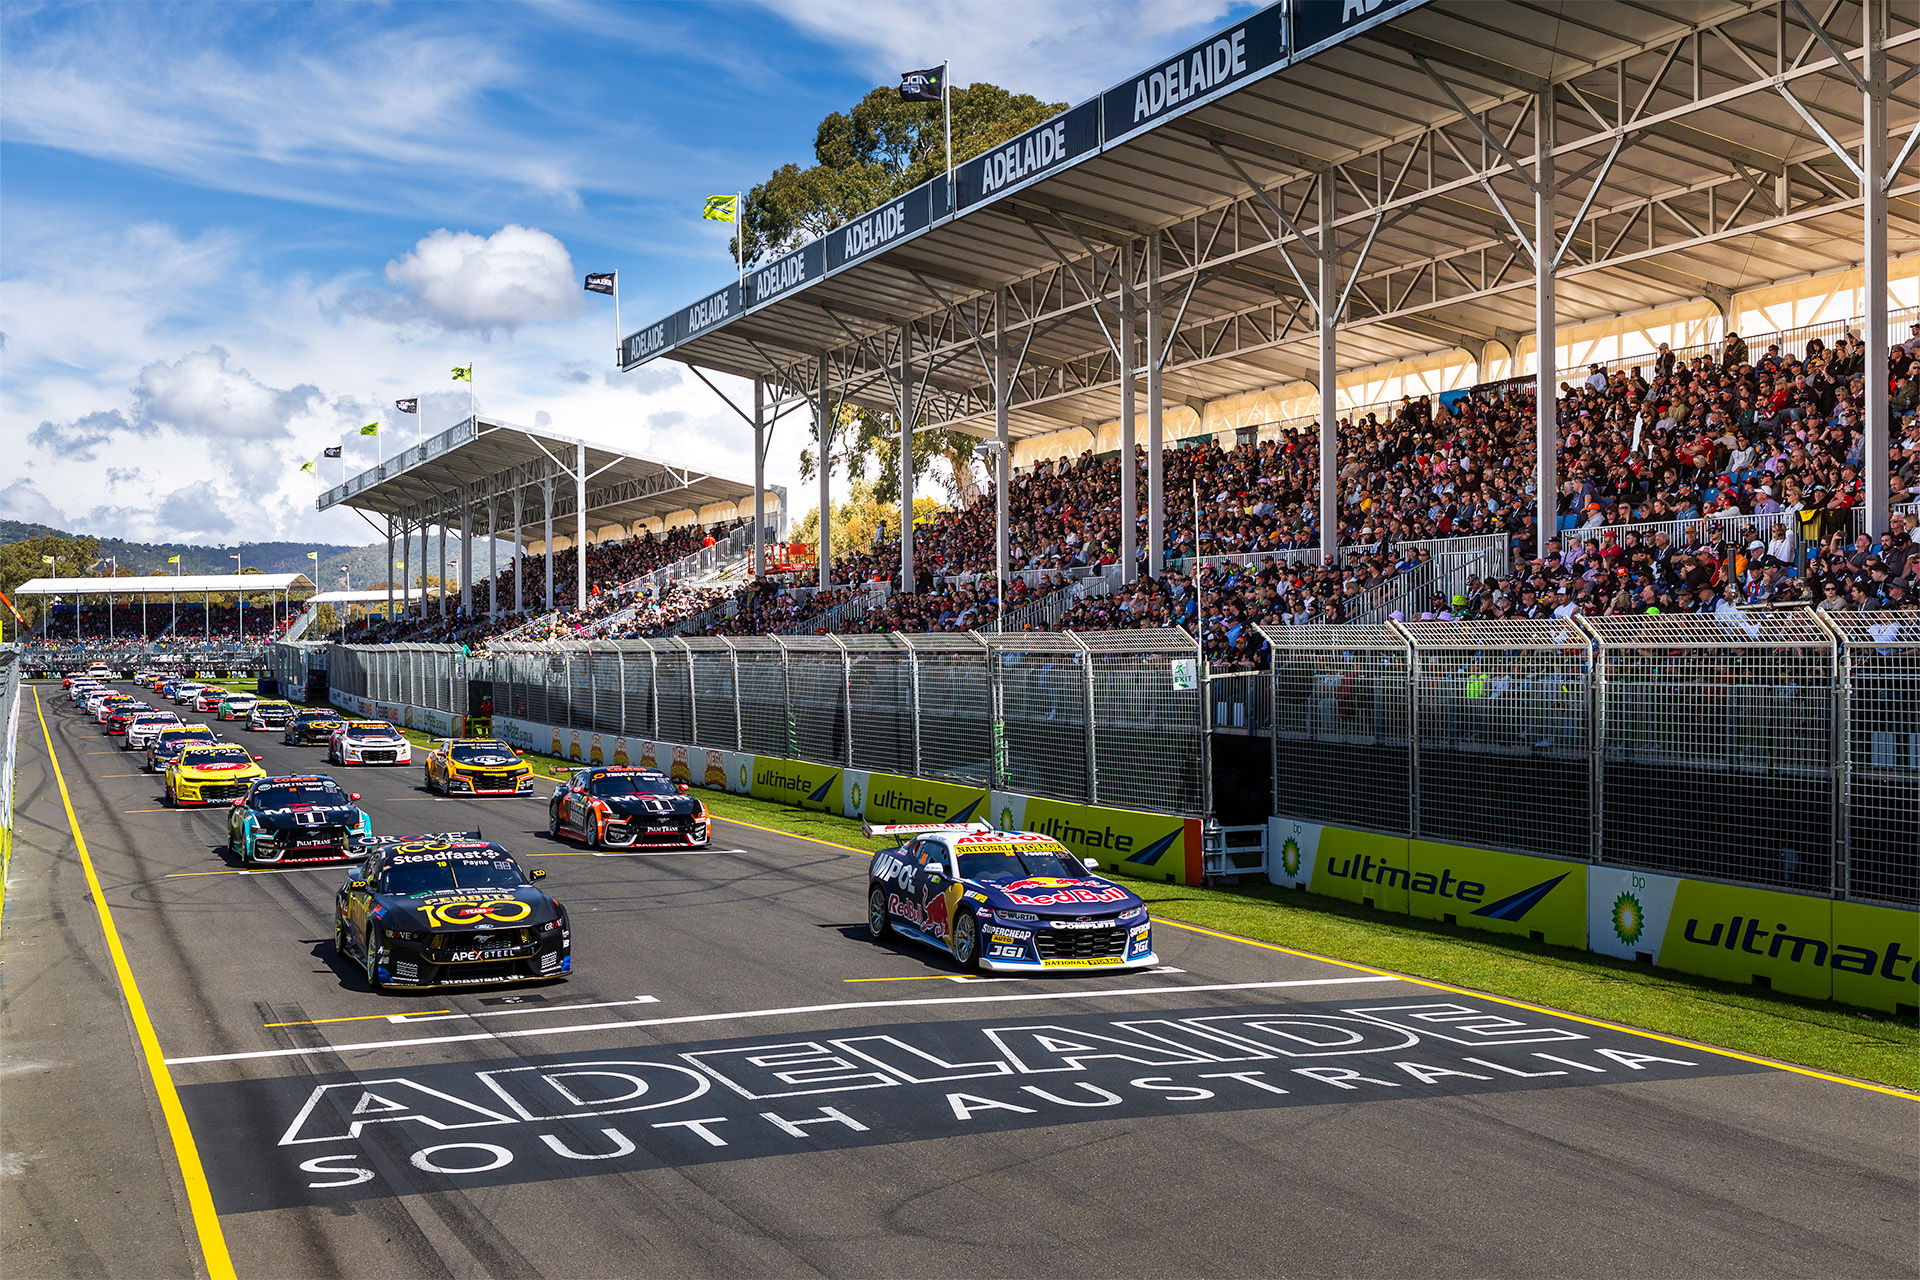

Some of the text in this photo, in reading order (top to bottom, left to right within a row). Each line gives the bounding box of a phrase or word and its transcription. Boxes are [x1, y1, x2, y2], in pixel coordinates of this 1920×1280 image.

[1133, 28, 1246, 123] ADELAIDE
[982, 120, 1065, 195] ADELAIDE
[844, 201, 905, 260] ADELAIDE
[757, 252, 805, 301] ADELAIDE
[688, 290, 729, 333] ADELAIDE
[631, 324, 664, 361] ADELAIDE
[200, 671, 216, 679] RAA
[232, 671, 247, 679] RAA
[1174, 675, 1192, 683] EXIT
[706, 749, 724, 769] MEGA
[757, 770, 812, 793] ultimate
[263, 805, 350, 815] Mobil
[874, 790, 948, 818] ultimate
[1030, 818, 1134, 852] ultimate
[1293, 822, 1302, 836] bp
[312, 839, 331, 847] TRANS
[358, 832, 465, 845] GROVE
[957, 835, 1053, 844] AMPOL
[392, 850, 481, 865] Steadfast
[957, 845, 1010, 853] NATIONAL
[463, 859, 489, 867] Payne
[1327, 854, 1486, 904] ultimate
[1632, 873, 1646, 891] bp
[385, 929, 412, 940] GROVE
[982, 923, 1031, 940] SUPERCHEAP
[451, 949, 514, 962] APEX STEEL
[989, 945, 1024, 958] JGI
[1684, 916, 1920, 986] ultimat
[277, 1004, 1589, 1145] ADELAIDE
[299, 1047, 1699, 1188] SOUTH AUSTRALIA
